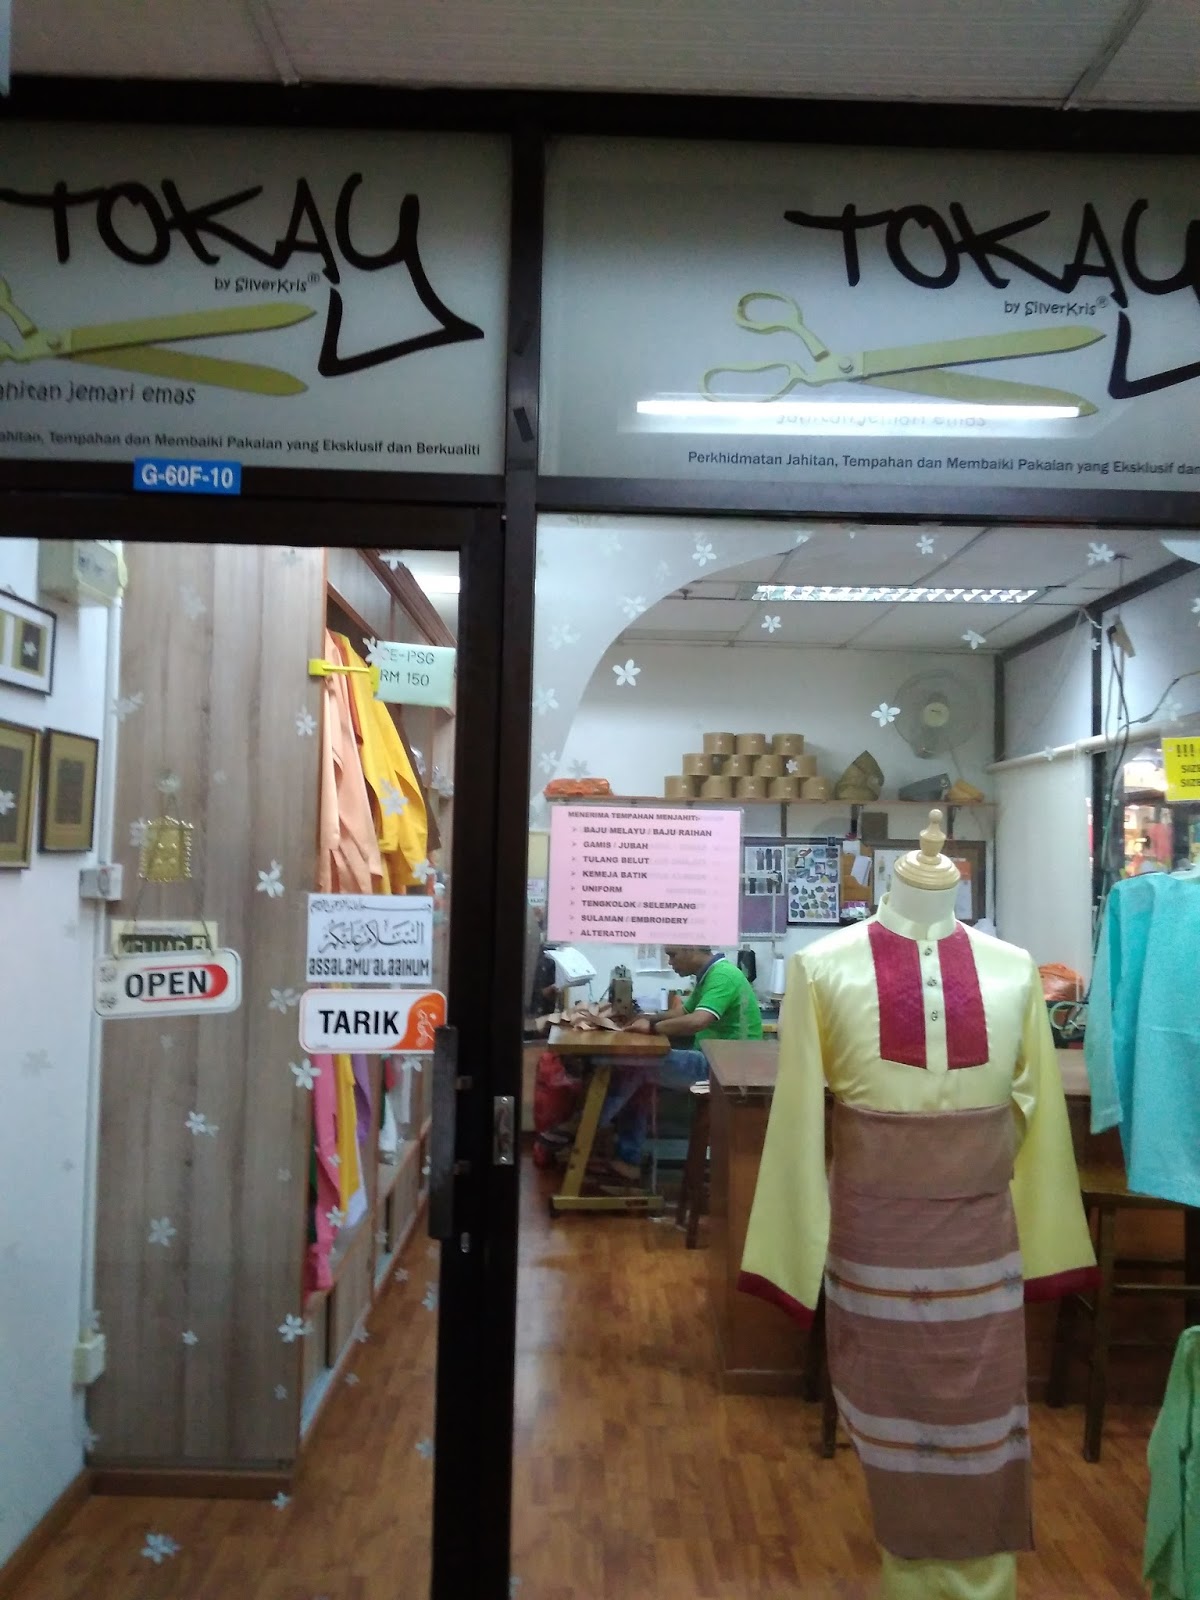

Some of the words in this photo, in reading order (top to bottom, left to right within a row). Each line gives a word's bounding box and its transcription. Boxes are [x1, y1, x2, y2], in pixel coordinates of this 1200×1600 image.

[214, 277, 231, 290] by
[1004, 301, 1020, 314] by
[142, 386, 196, 405] emas
[49, 431, 121, 447] Tempahan
[125, 433, 150, 445] dan
[155, 433, 222, 448] Membaiki
[227, 436, 282, 450] Pakaian
[286, 439, 319, 454] yang
[323, 438, 383, 453] Eksklusif
[387, 441, 412, 454] dan
[416, 441, 480, 456] Berkualiti
[687, 451, 782, 465] Perkhidmatan
[786, 454, 838, 468] Jahitan,
[842, 455, 913, 470] Tempahan
[917, 457, 942, 469] dan
[947, 457, 1013, 470] Membaiki
[1018, 459, 1073, 472] Pakaian
[1077, 462, 1109, 475] yang
[1113, 460, 1174, 474] Eksklusif
[141, 463, 233, 489] G-60F-10
[380, 669, 400, 683] RM
[407, 672, 430, 687] 150
[568, 811, 609, 819] MENERIMA
[611, 812, 654, 820] TEMPAHAN
[584, 826, 607, 834] BAJU
[609, 827, 646, 835] MELAYU
[653, 828, 676, 836] BAJU
[678, 829, 712, 837] RAIHAN
[583, 841, 611, 849] GAMIS
[618, 842, 648, 850] JUBAH
[582, 871, 618, 879] KEMEJA
[621, 871, 648, 879] BATIK
[582, 885, 622, 893] UNIFORM
[582, 900, 636, 908] TENGKOLOK
[643, 901, 696, 910] SELEMPANG
[581, 914, 624, 923] SULAMAN
[631, 916, 688, 925] EMBROIDERY
[580, 929, 636, 938] ALTERATION
[125, 970, 207, 999] OPEN
[318, 1009, 399, 1035] TARIK
